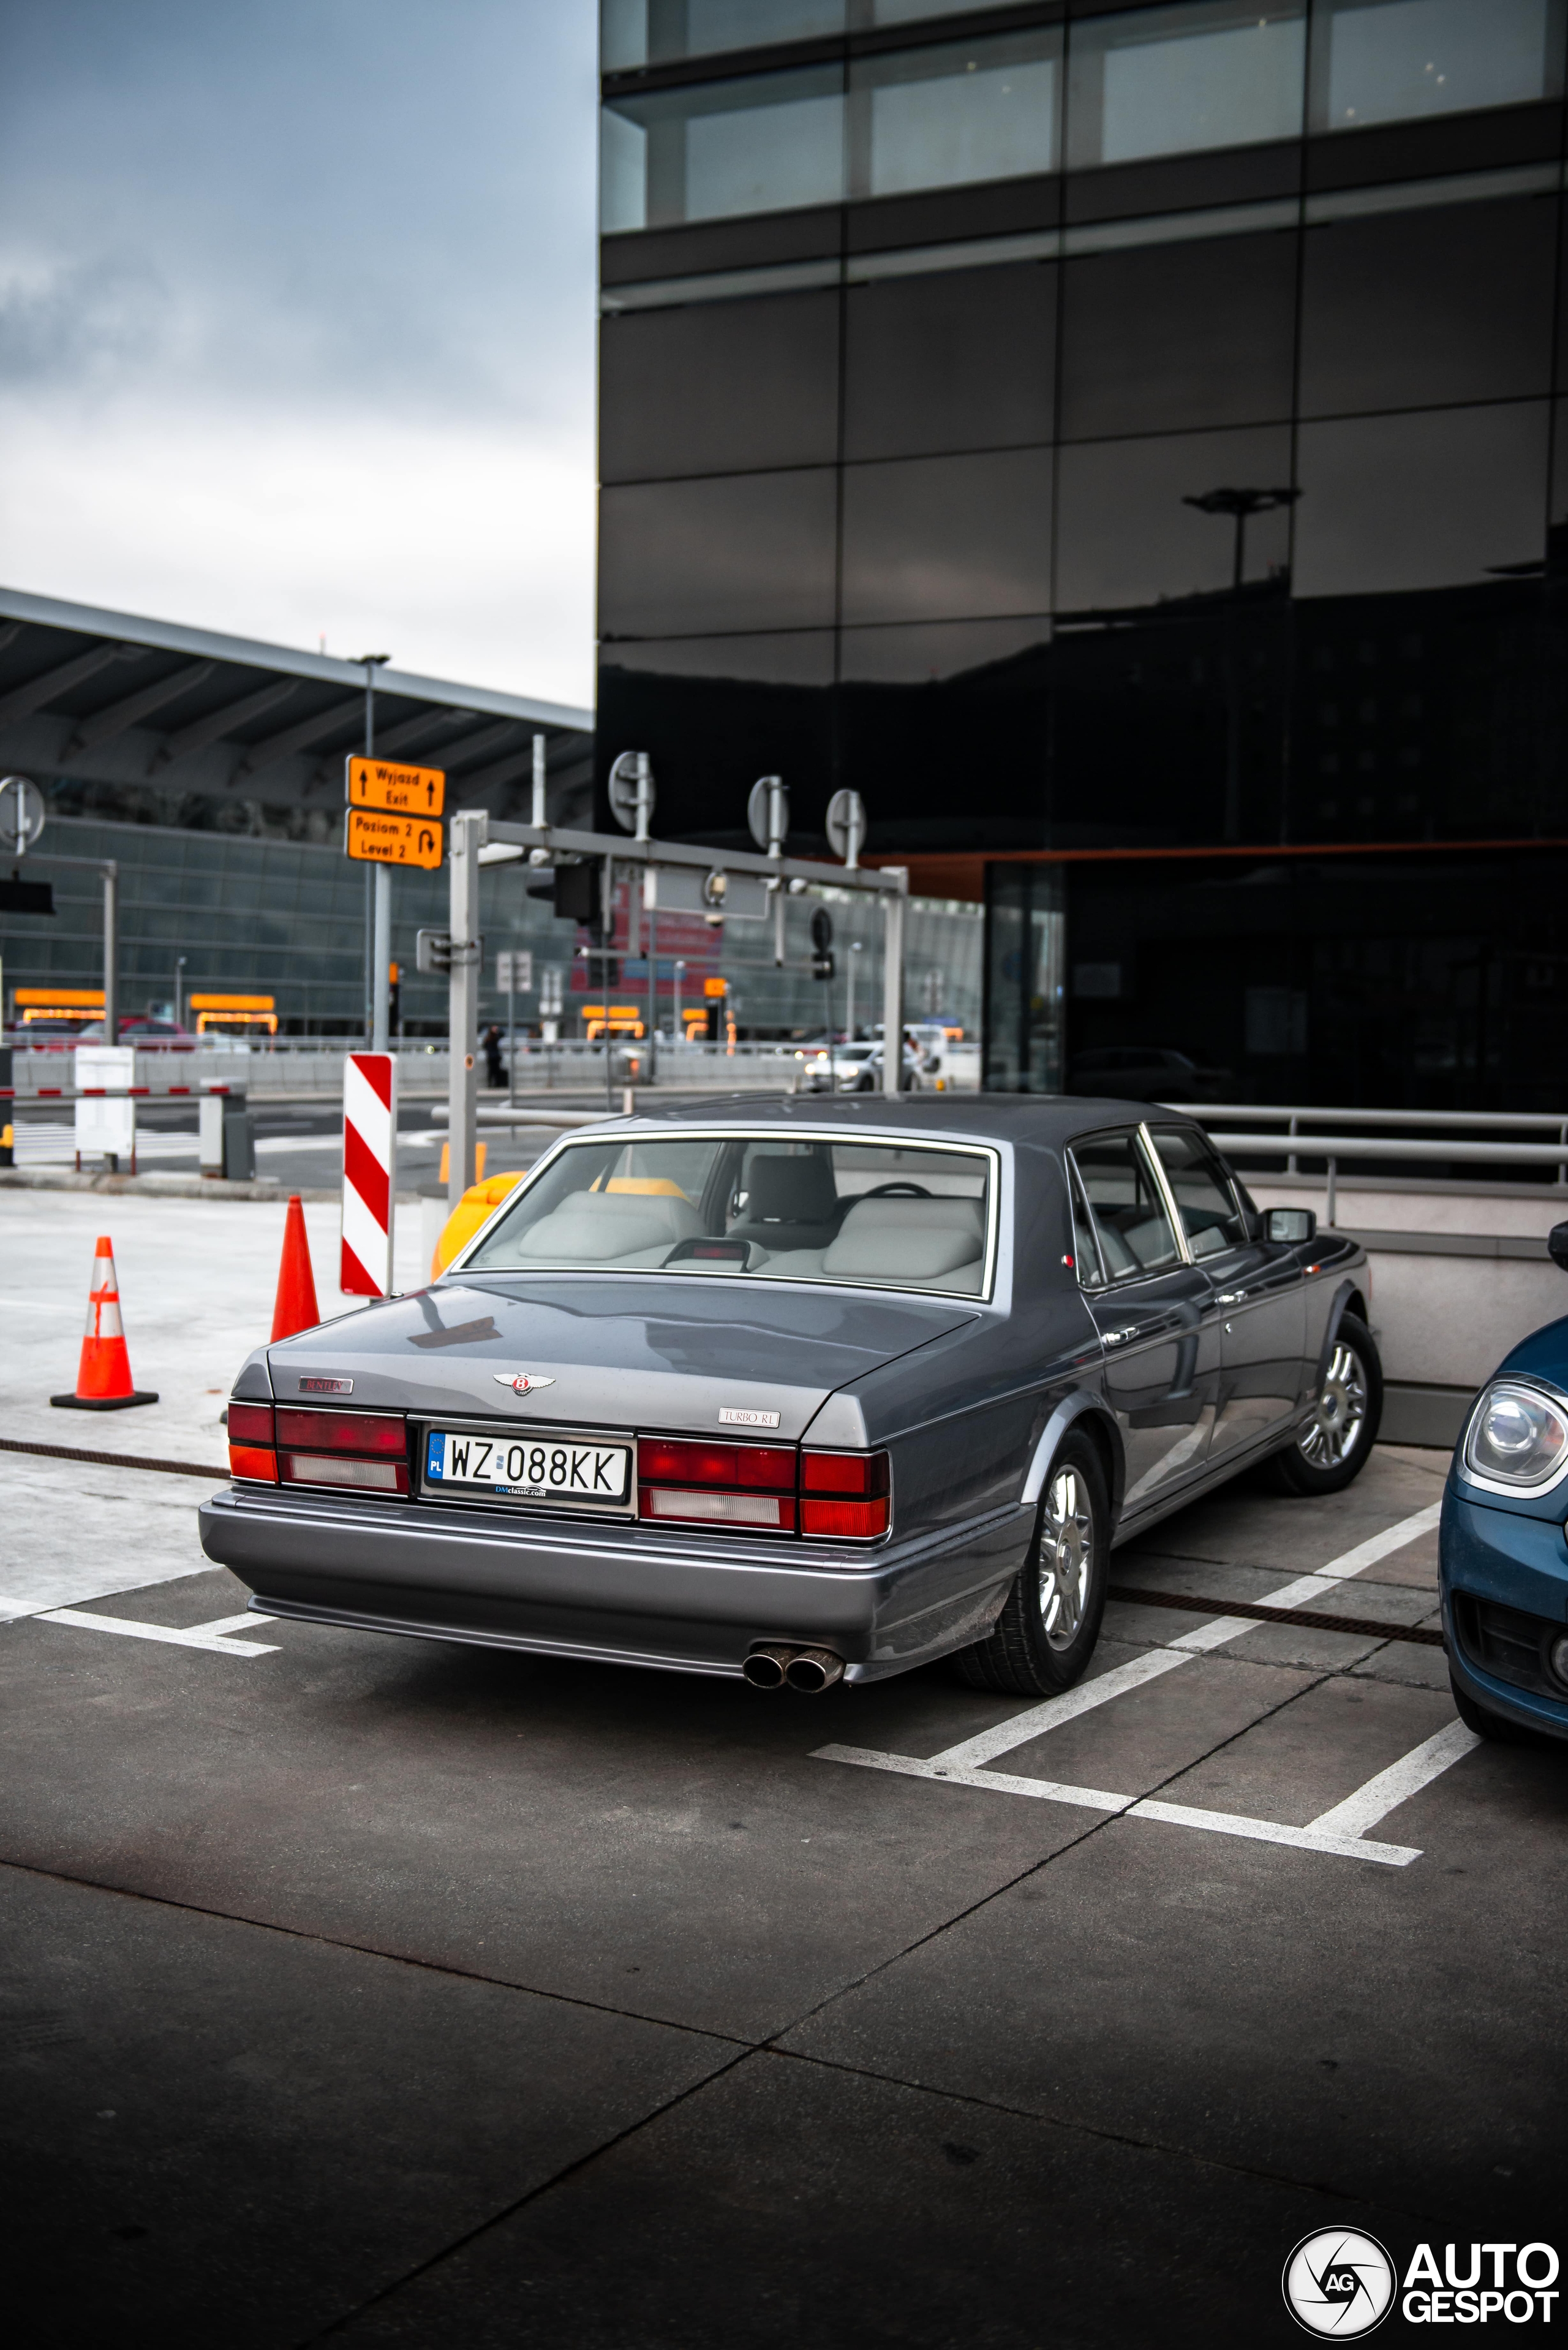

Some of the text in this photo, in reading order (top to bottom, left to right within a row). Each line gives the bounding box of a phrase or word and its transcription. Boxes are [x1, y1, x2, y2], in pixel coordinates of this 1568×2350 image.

[375, 767, 420, 786] Wyjazd
[386, 790, 408, 806] Exit
[356, 816, 413, 837] Poziom 2
[361, 839, 405, 858] Level 2
[307, 1380, 343, 1390] BENTLEY
[725, 1411, 774, 1424] TURBO RL
[431, 1460, 442, 1472] PL
[496, 1486, 546, 1497] DMclassic.com
